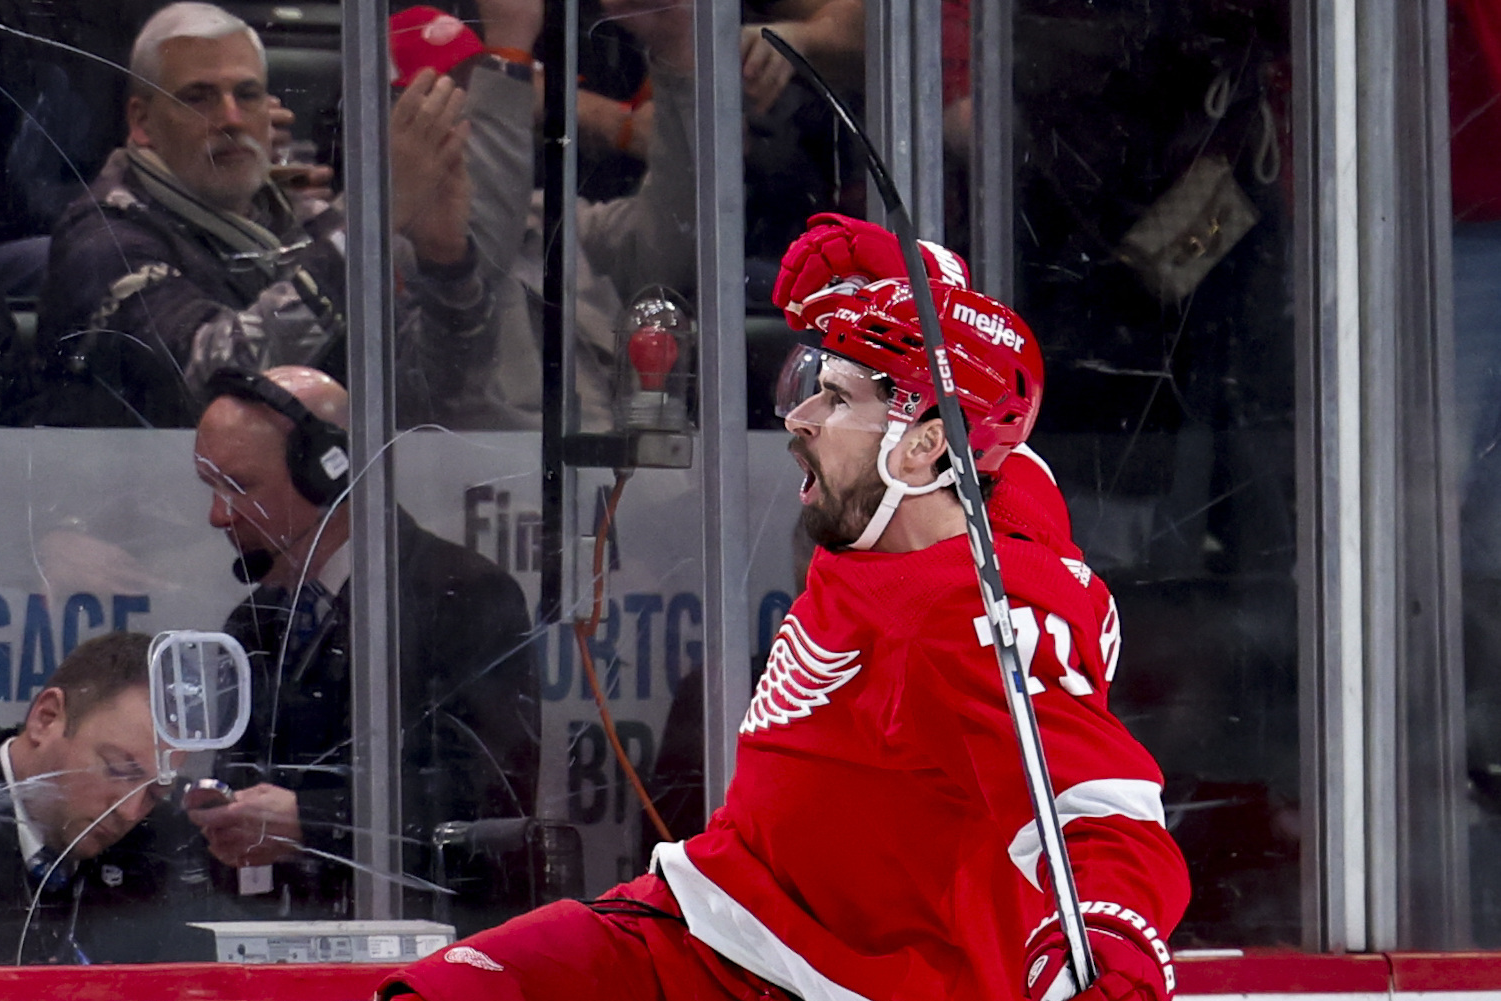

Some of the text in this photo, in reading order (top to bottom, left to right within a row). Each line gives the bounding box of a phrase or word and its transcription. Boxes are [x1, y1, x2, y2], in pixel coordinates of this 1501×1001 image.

[952, 303, 1025, 354] meijer
[934, 346, 956, 394] CCM
[465, 485, 543, 572] Fin
[973, 606, 1094, 697] 71
